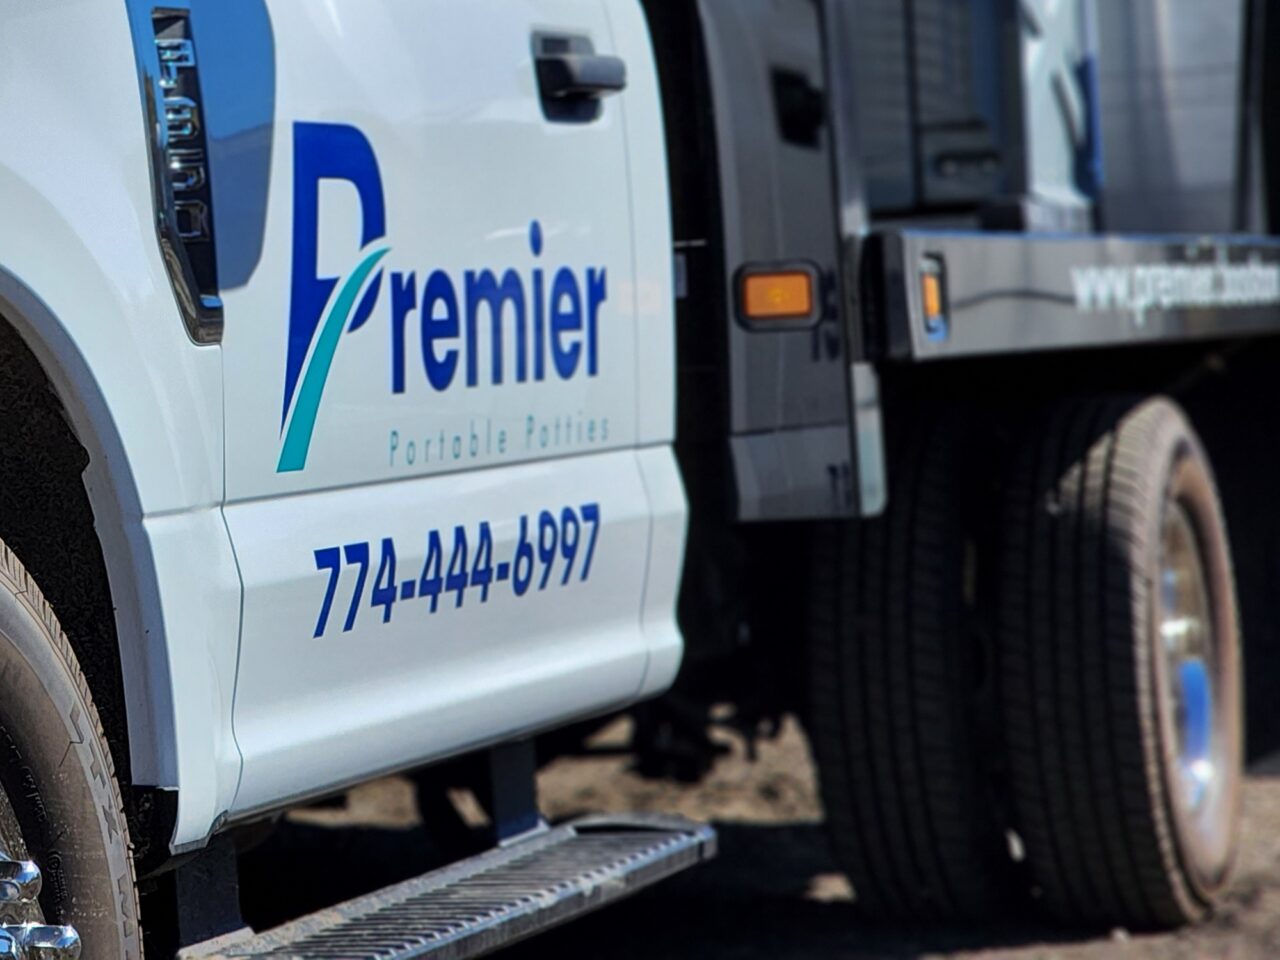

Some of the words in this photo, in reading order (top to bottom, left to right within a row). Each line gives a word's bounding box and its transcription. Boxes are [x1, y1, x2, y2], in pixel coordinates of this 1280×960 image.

[275, 120, 608, 474] Premier
[389, 418, 507, 468] Portable
[525, 409, 610, 450] Potties
[312, 502, 601, 640] 774-444-6997
